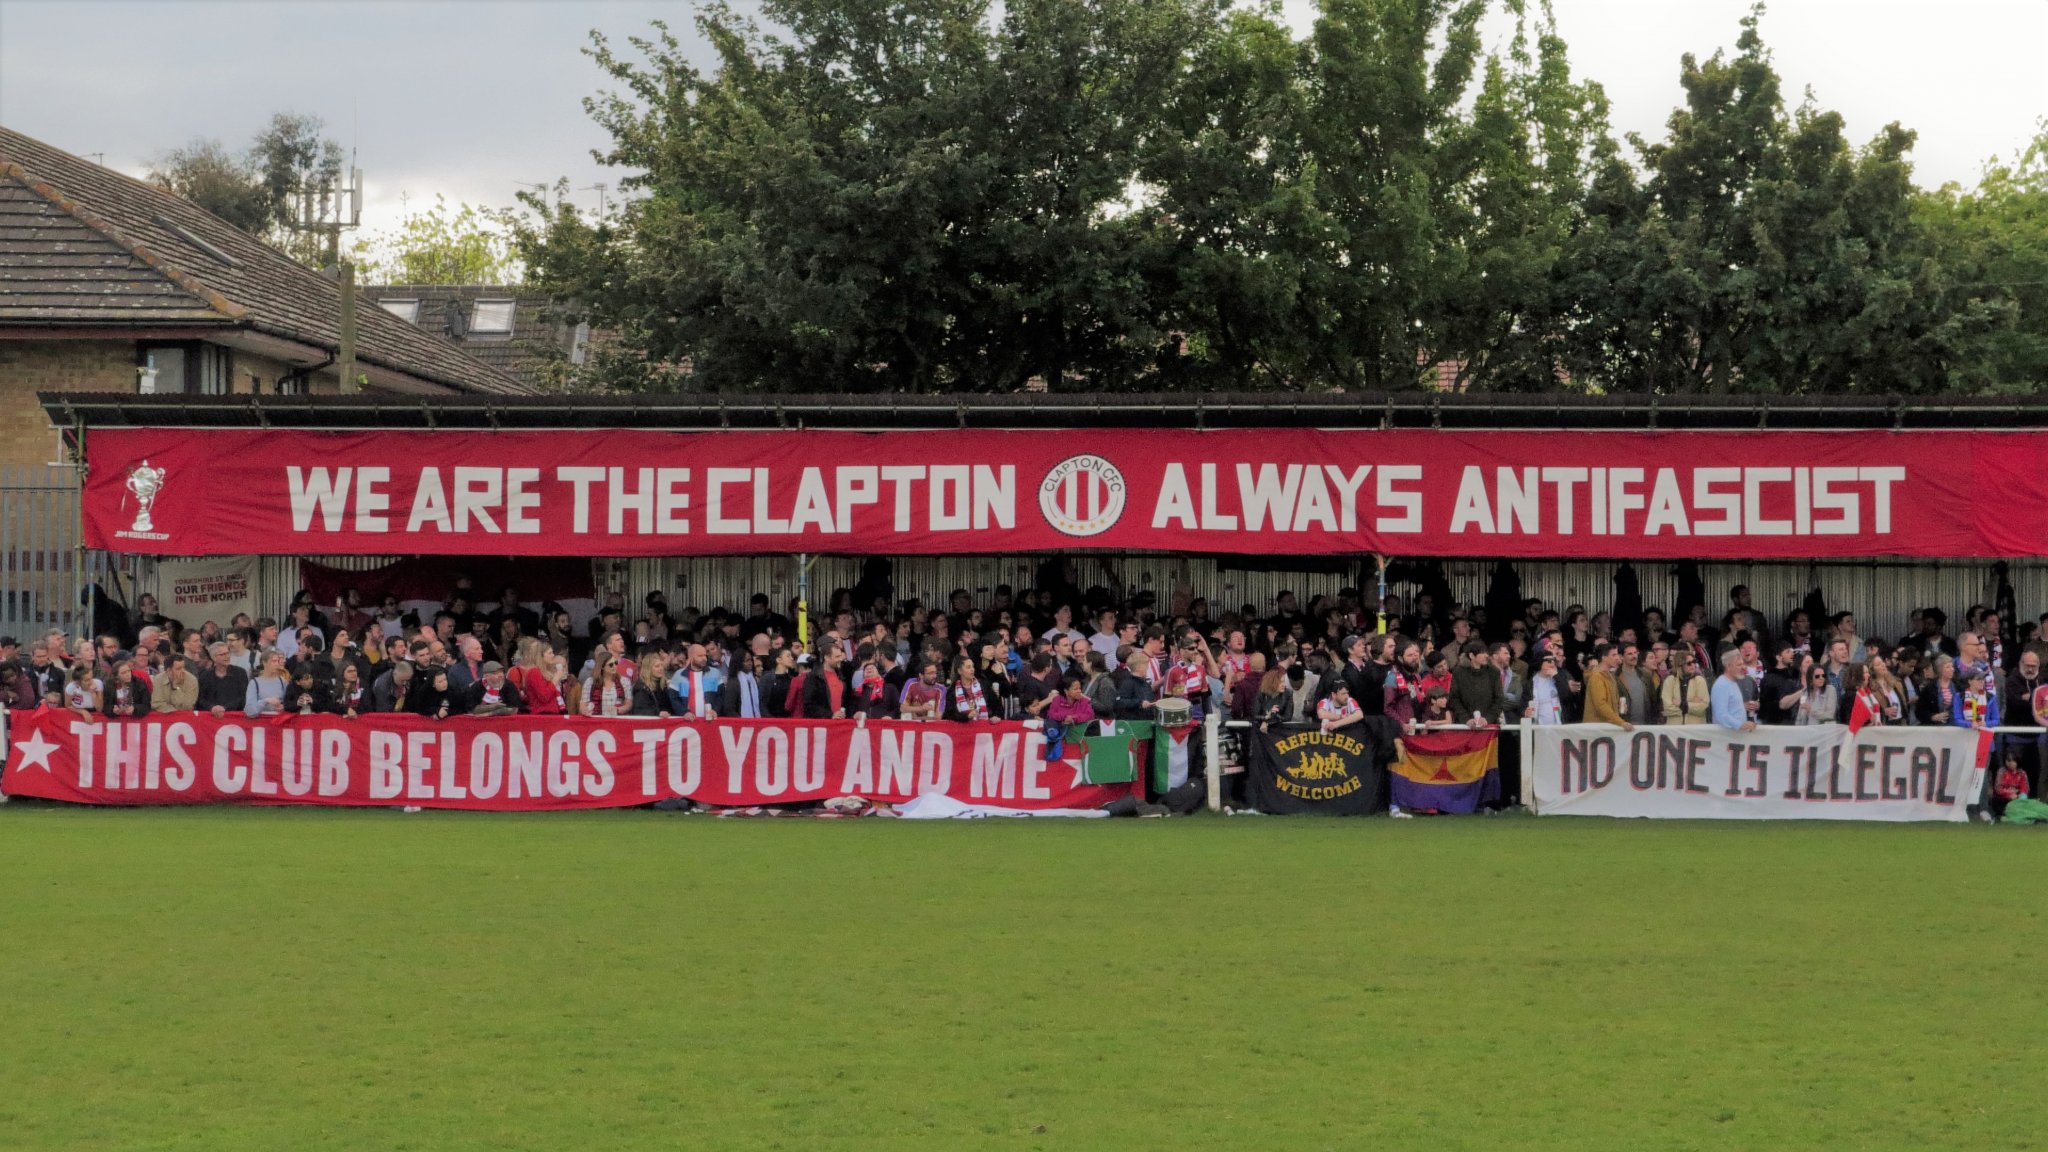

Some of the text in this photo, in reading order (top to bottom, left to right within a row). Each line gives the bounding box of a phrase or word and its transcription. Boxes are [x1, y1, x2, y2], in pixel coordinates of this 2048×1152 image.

[1044, 457, 1122, 492] CLAPTON CFC
[287, 465, 1016, 534] WE ARE THE CLAPTON
[1152, 463, 1905, 535] ALWAYS ANTIFASCIST
[174, 580, 247, 595] OUR FRIENDS
[175, 590, 247, 604] IN THE NORTH
[70, 721, 1050, 799] THIS CLUB BELONGS TO YOU AND ME
[1275, 731, 1364, 755] REFUGEES
[1561, 731, 1956, 805] NO ONE IS ILLEGAL
[1276, 774, 1362, 800] WELCOME
